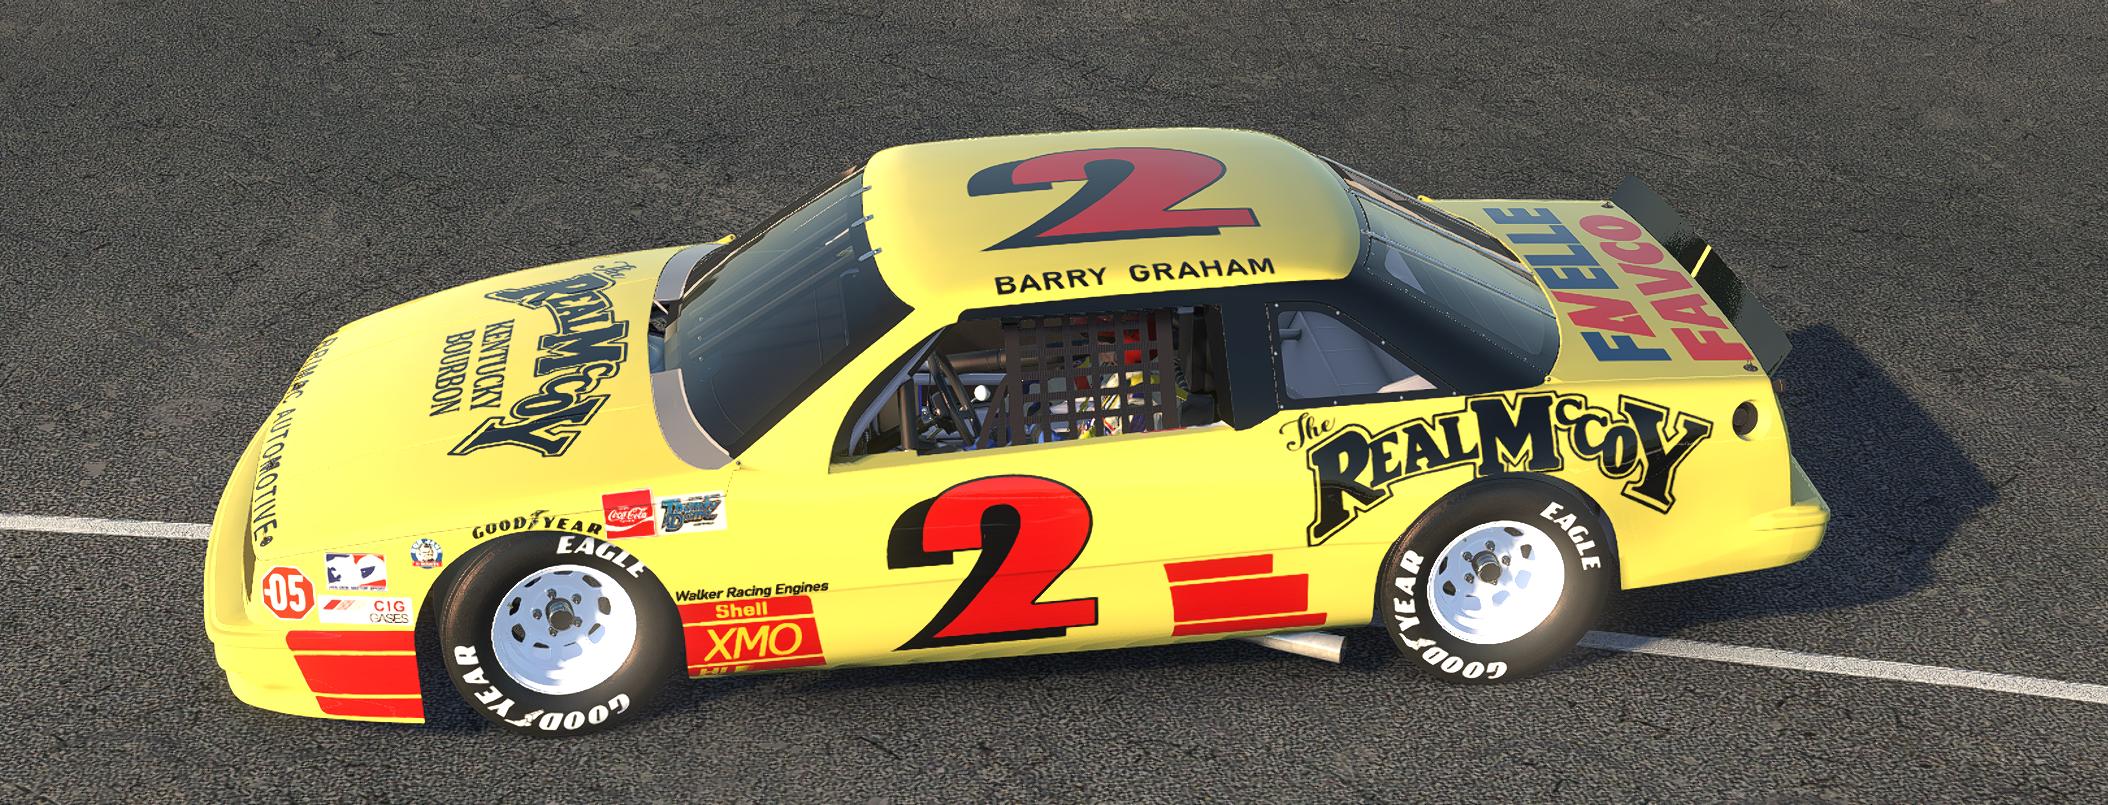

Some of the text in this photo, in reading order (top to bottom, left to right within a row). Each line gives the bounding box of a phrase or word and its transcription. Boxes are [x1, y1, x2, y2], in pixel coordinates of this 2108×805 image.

[966, 146, 1261, 252] 2
[994, 258, 1276, 295] BARRY GRAHAM
[1579, 215, 1754, 361] FAVCO
[430, 329, 477, 417] BOURBON
[469, 318, 515, 410] KENTUCKY
[1279, 411, 1336, 451] The
[253, 408, 296, 541] AUTOMOTIVE
[1307, 413, 1480, 546] REAL
[556, 535, 649, 579] EAGLE
[887, 473, 1099, 652] 2
[1540, 501, 1601, 571] EAGLE
[370, 612, 409, 624] GASES
[374, 600, 405, 612] CIG
[675, 582, 829, 601] Walker Racing Engines
[715, 601, 768, 619] Shell
[704, 622, 803, 662] XMO
